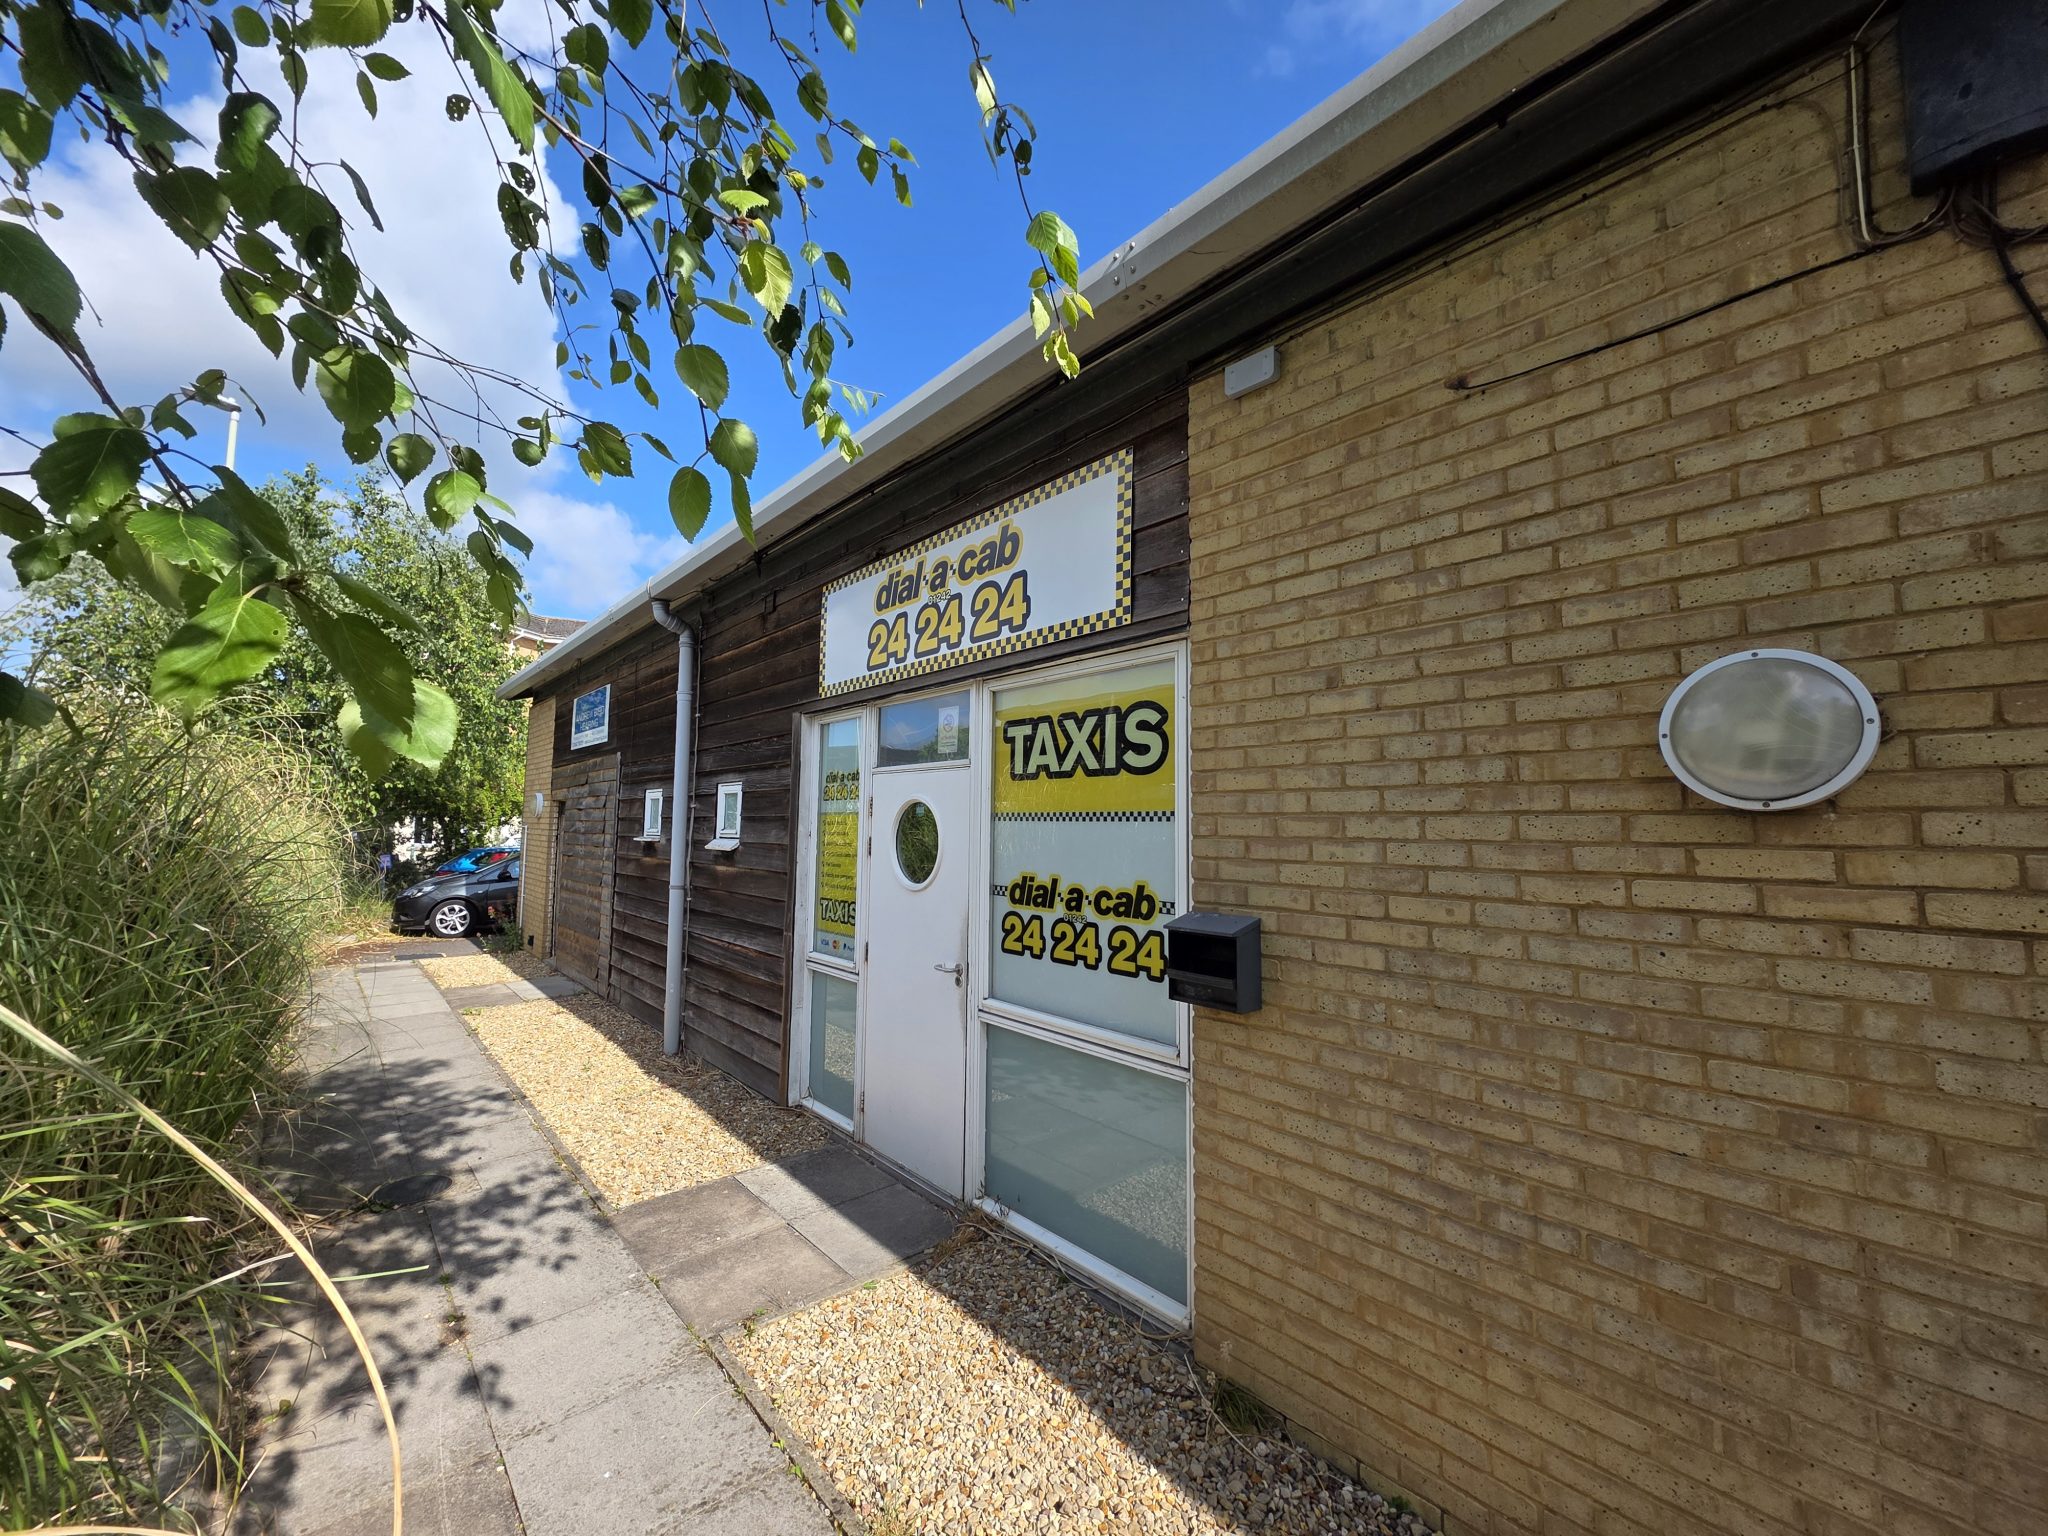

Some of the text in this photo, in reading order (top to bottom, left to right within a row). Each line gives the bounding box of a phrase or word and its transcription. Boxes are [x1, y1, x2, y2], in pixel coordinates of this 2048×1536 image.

[867, 570, 1031, 671] 24 24 24
[928, 589, 952, 604] 01242
[1003, 701, 1169, 781] TAXIS
[1001, 911, 1168, 983] 24 24 24
[1063, 912, 1087, 924] 01242
